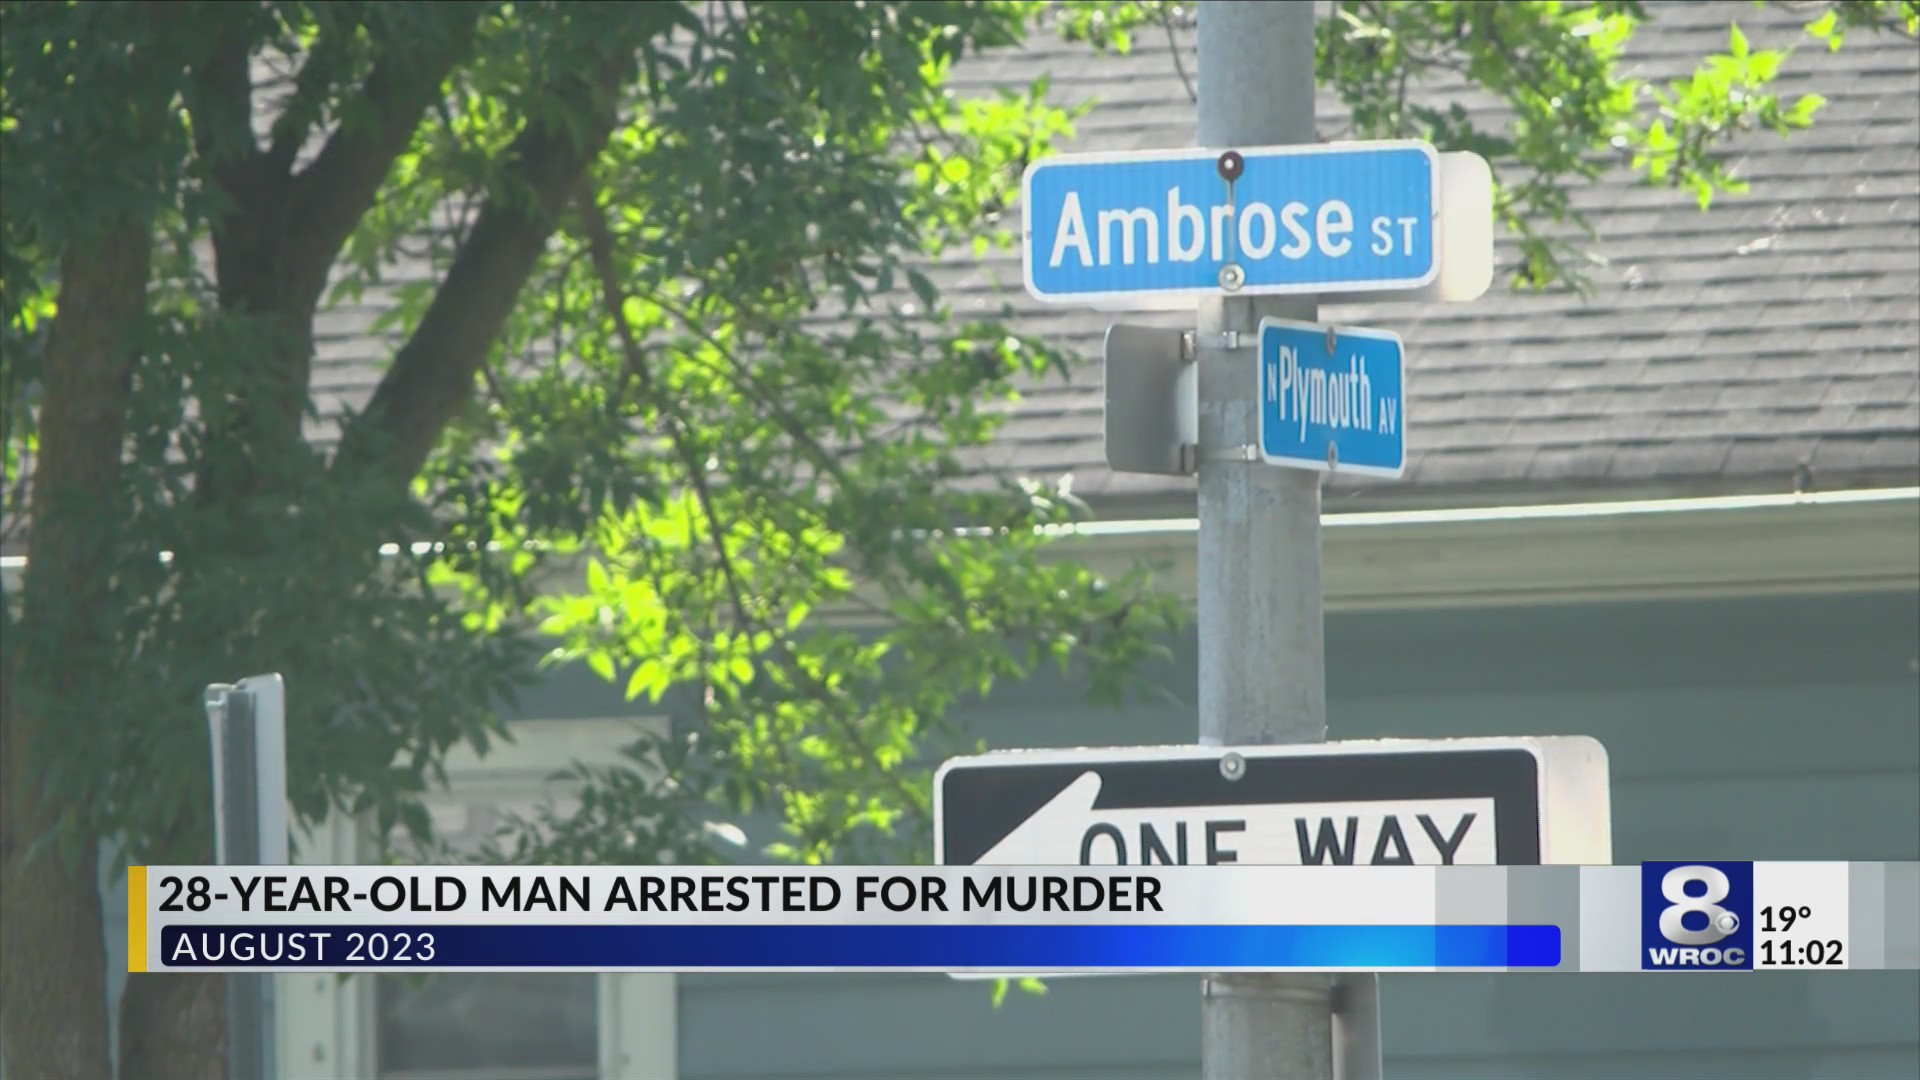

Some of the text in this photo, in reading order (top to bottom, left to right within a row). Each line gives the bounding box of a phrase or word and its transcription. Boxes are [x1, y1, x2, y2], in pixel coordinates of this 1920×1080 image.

[1049, 186, 1418, 267] Ambrose ST
[1267, 345, 1396, 443] N Plymouth AV
[1294, 813, 1477, 864] WAY
